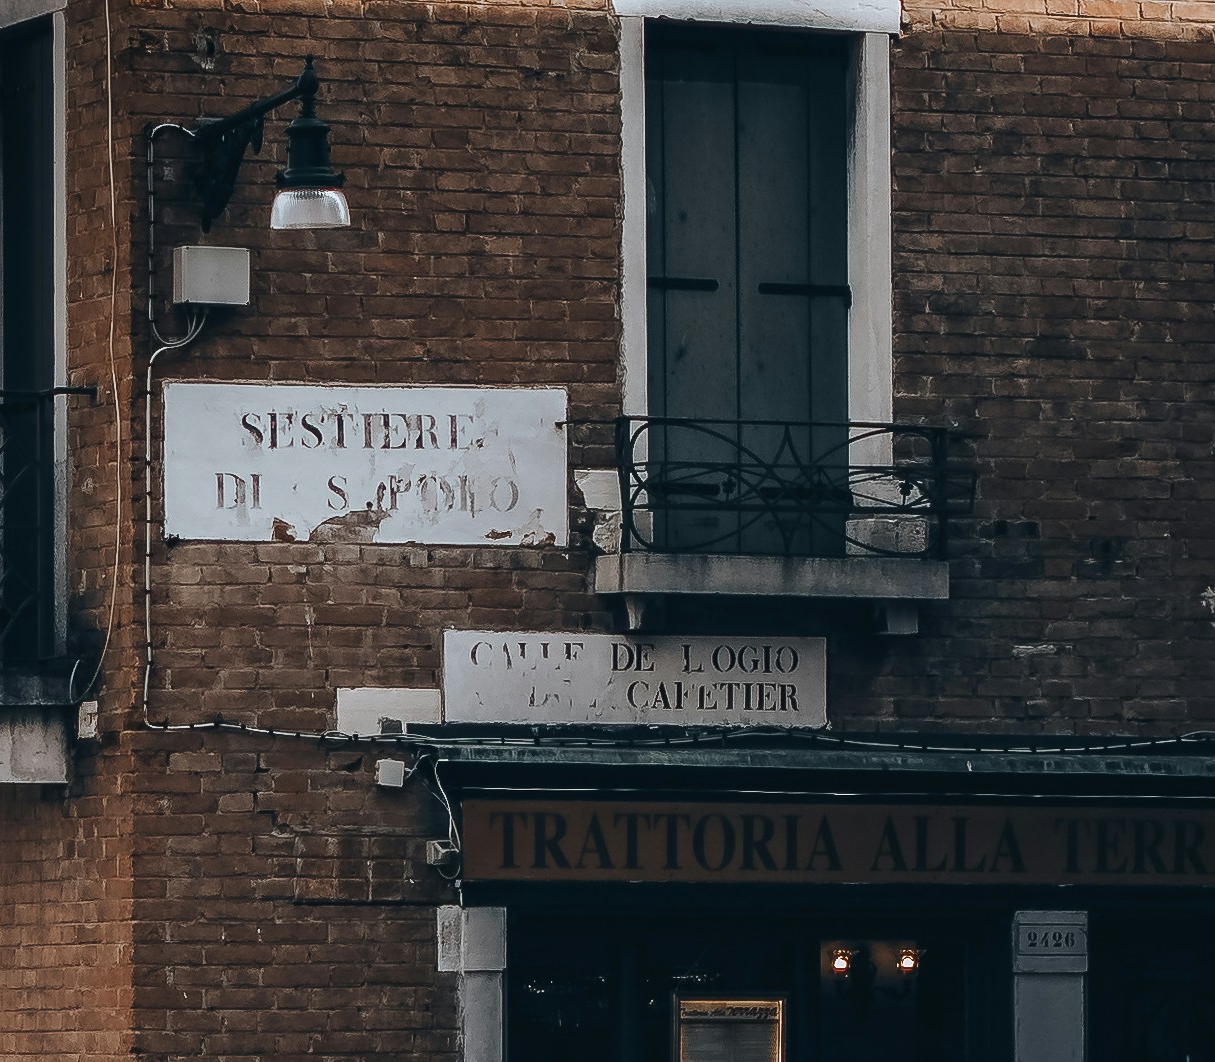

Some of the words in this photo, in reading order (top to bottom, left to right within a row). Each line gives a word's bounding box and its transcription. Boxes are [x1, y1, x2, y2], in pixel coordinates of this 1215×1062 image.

[214, 473, 263, 510] DI
[611, 642, 656, 672] DE
[488, 811, 844, 873] TRATTORIA
[871, 814, 1027, 874] ALLA
[1054, 817, 1215, 874] TERR
[1027, 931, 1075, 948] 2426
